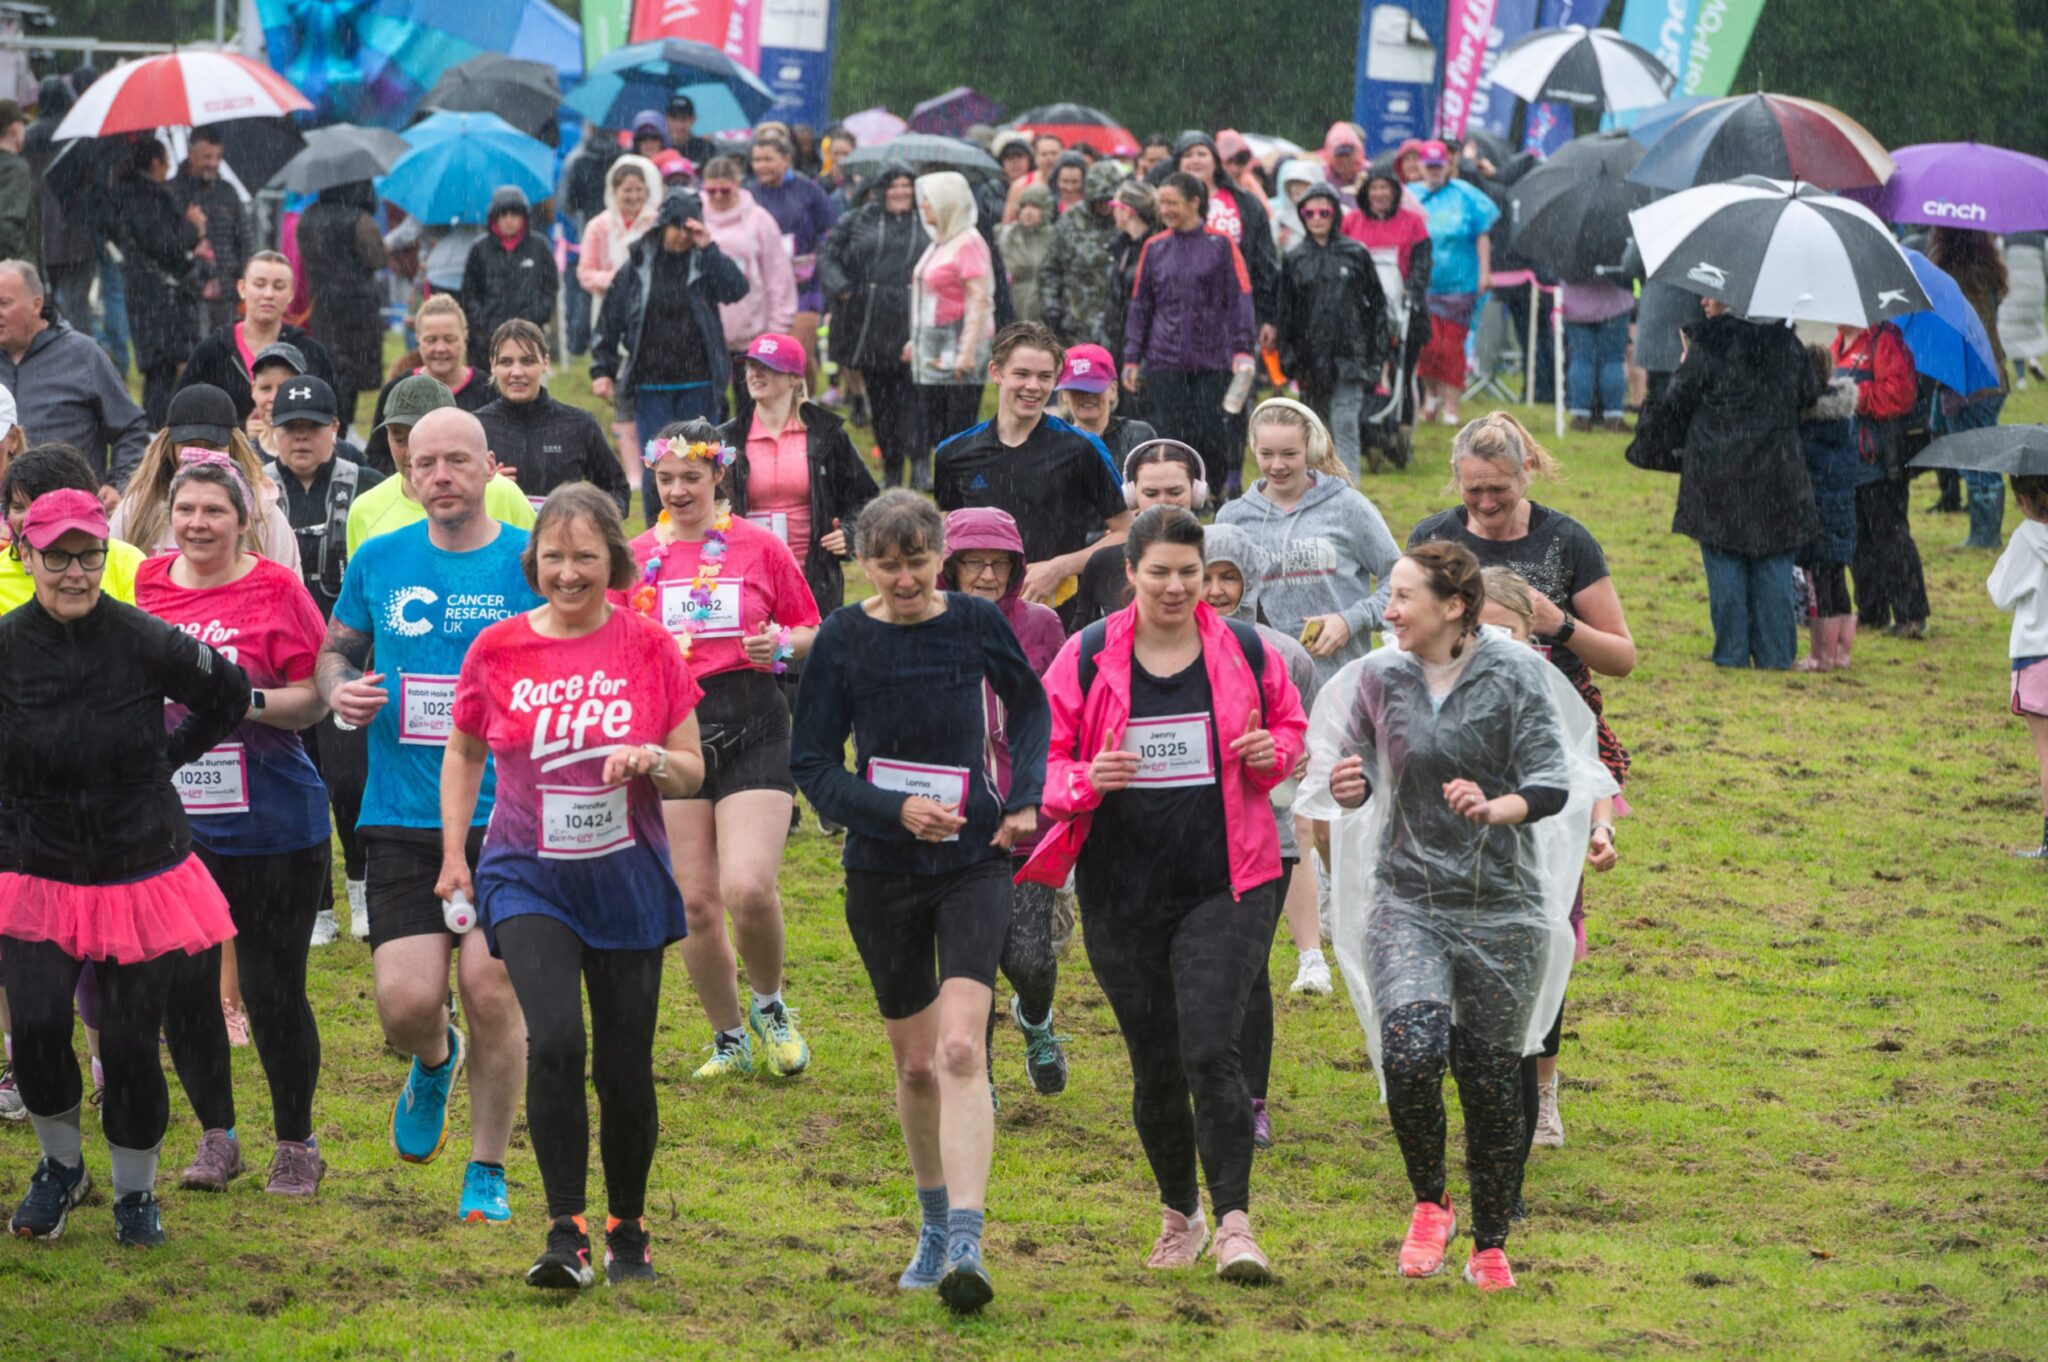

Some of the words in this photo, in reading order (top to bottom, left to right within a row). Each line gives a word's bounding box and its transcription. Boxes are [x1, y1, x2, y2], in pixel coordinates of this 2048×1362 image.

[1447, 34, 1477, 89] for
[1923, 196, 1986, 221] cinch
[1292, 537, 1316, 550] THE
[1270, 547, 1317, 564] NORTH
[1289, 560, 1317, 571] FACE
[446, 594, 505, 607] CANCER
[200, 619, 240, 642] for
[443, 621, 463, 633] UK
[407, 688, 430, 697] Rabbit
[509, 674, 584, 713] Race
[587, 670, 628, 697] for
[530, 699, 632, 760] Life
[1150, 732, 1176, 740] Jenny
[1139, 742, 1188, 759] 10325
[180, 771, 222, 785] 10233
[905, 779, 931, 788] Lorna
[572, 801, 608, 810] Jennifer
[565, 810, 612, 829] 10424
